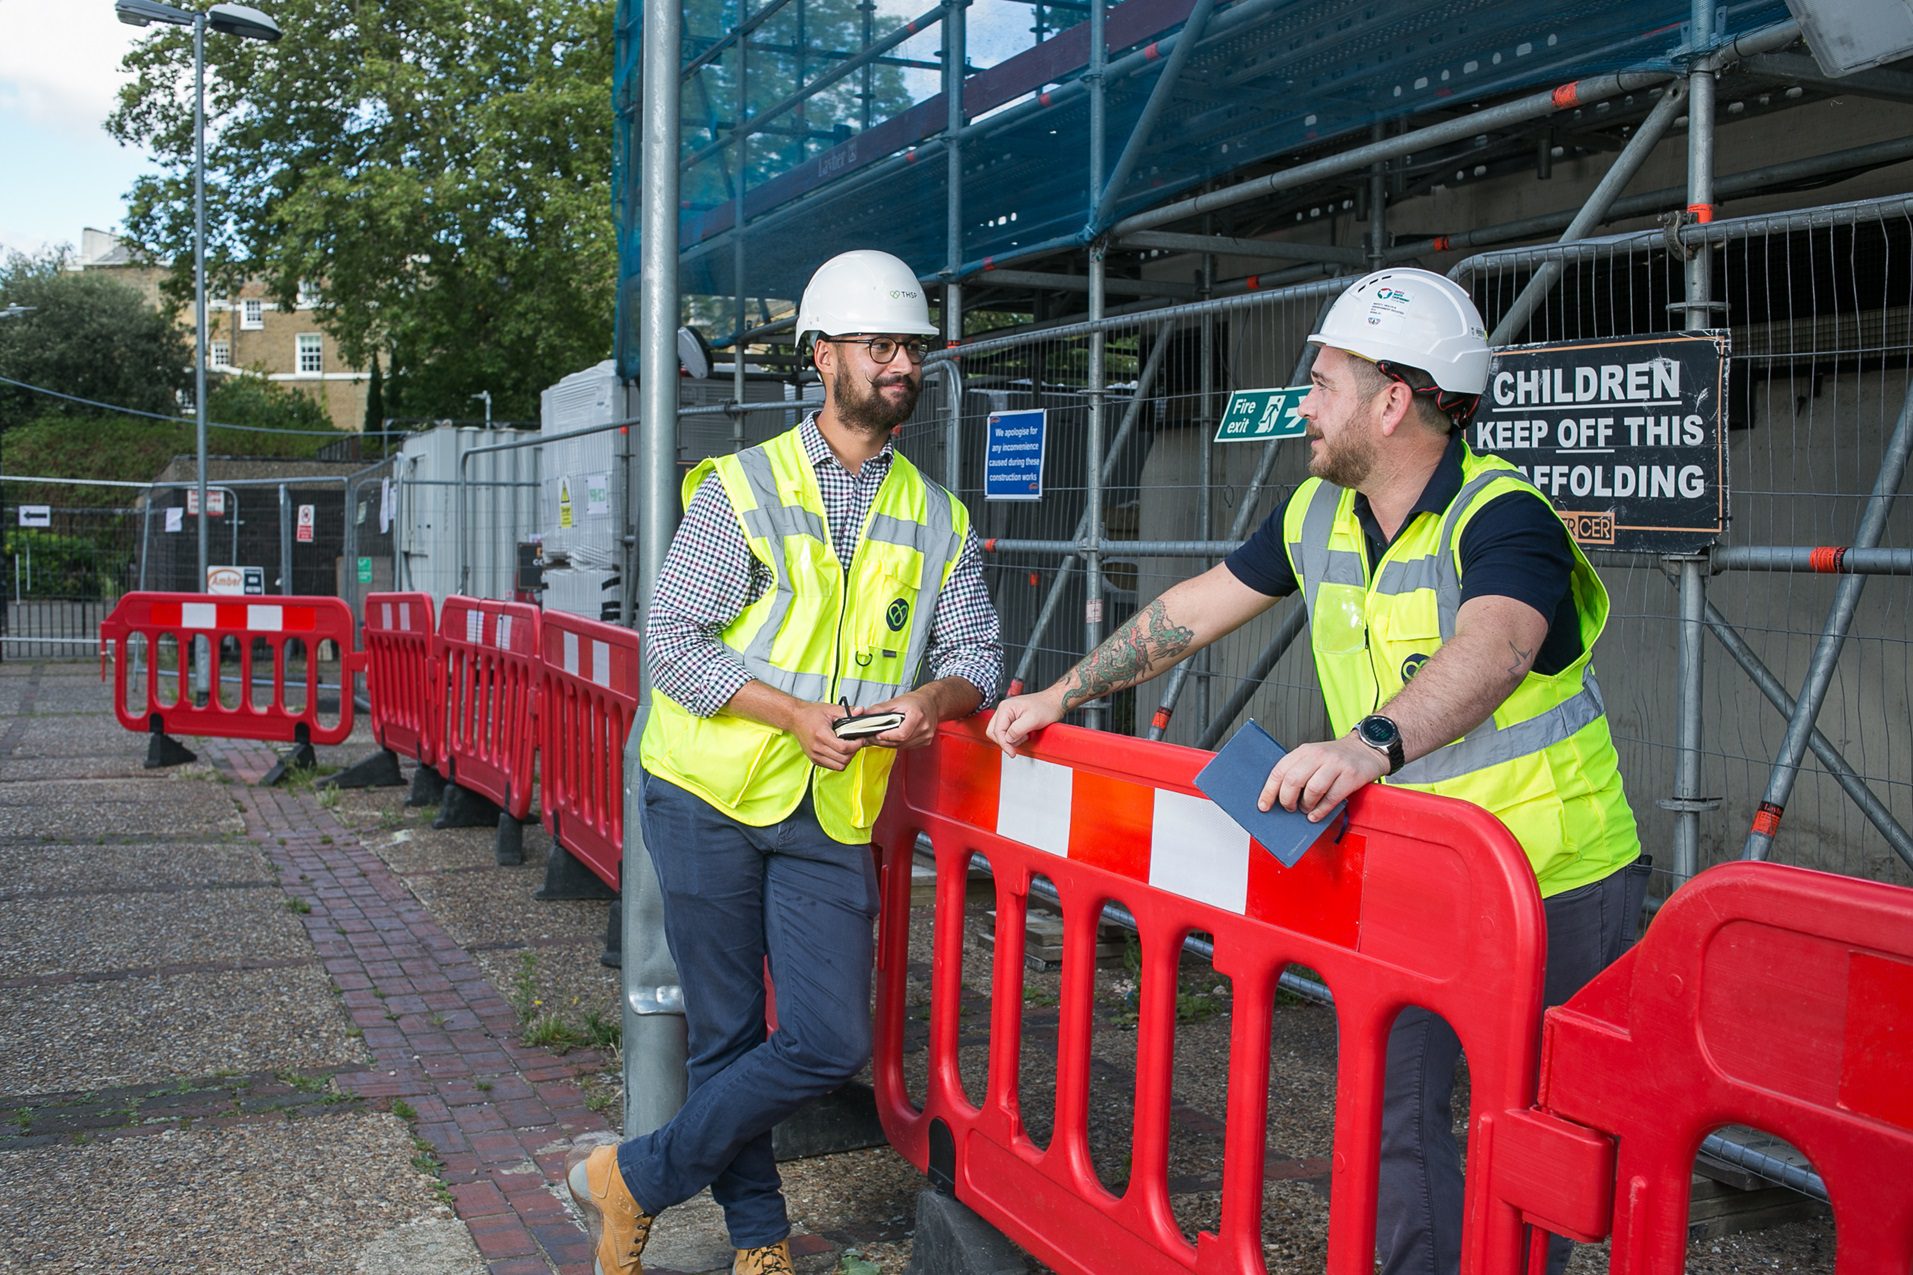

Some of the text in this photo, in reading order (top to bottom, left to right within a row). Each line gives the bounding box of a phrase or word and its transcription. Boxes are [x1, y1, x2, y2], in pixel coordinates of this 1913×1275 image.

[1492, 360, 1681, 406] CHILDREN
[1232, 398, 1257, 415] Fire
[995, 426, 1038, 438] We apologise for
[1226, 418, 1250, 434] exit
[1476, 415, 1705, 449] KEEP OFF THIS
[991, 442, 1039, 454] any inconvenience
[988, 457, 1040, 468] caused during these
[989, 472, 1021, 482] construction
[1518, 465, 1705, 498] FFOLDING
